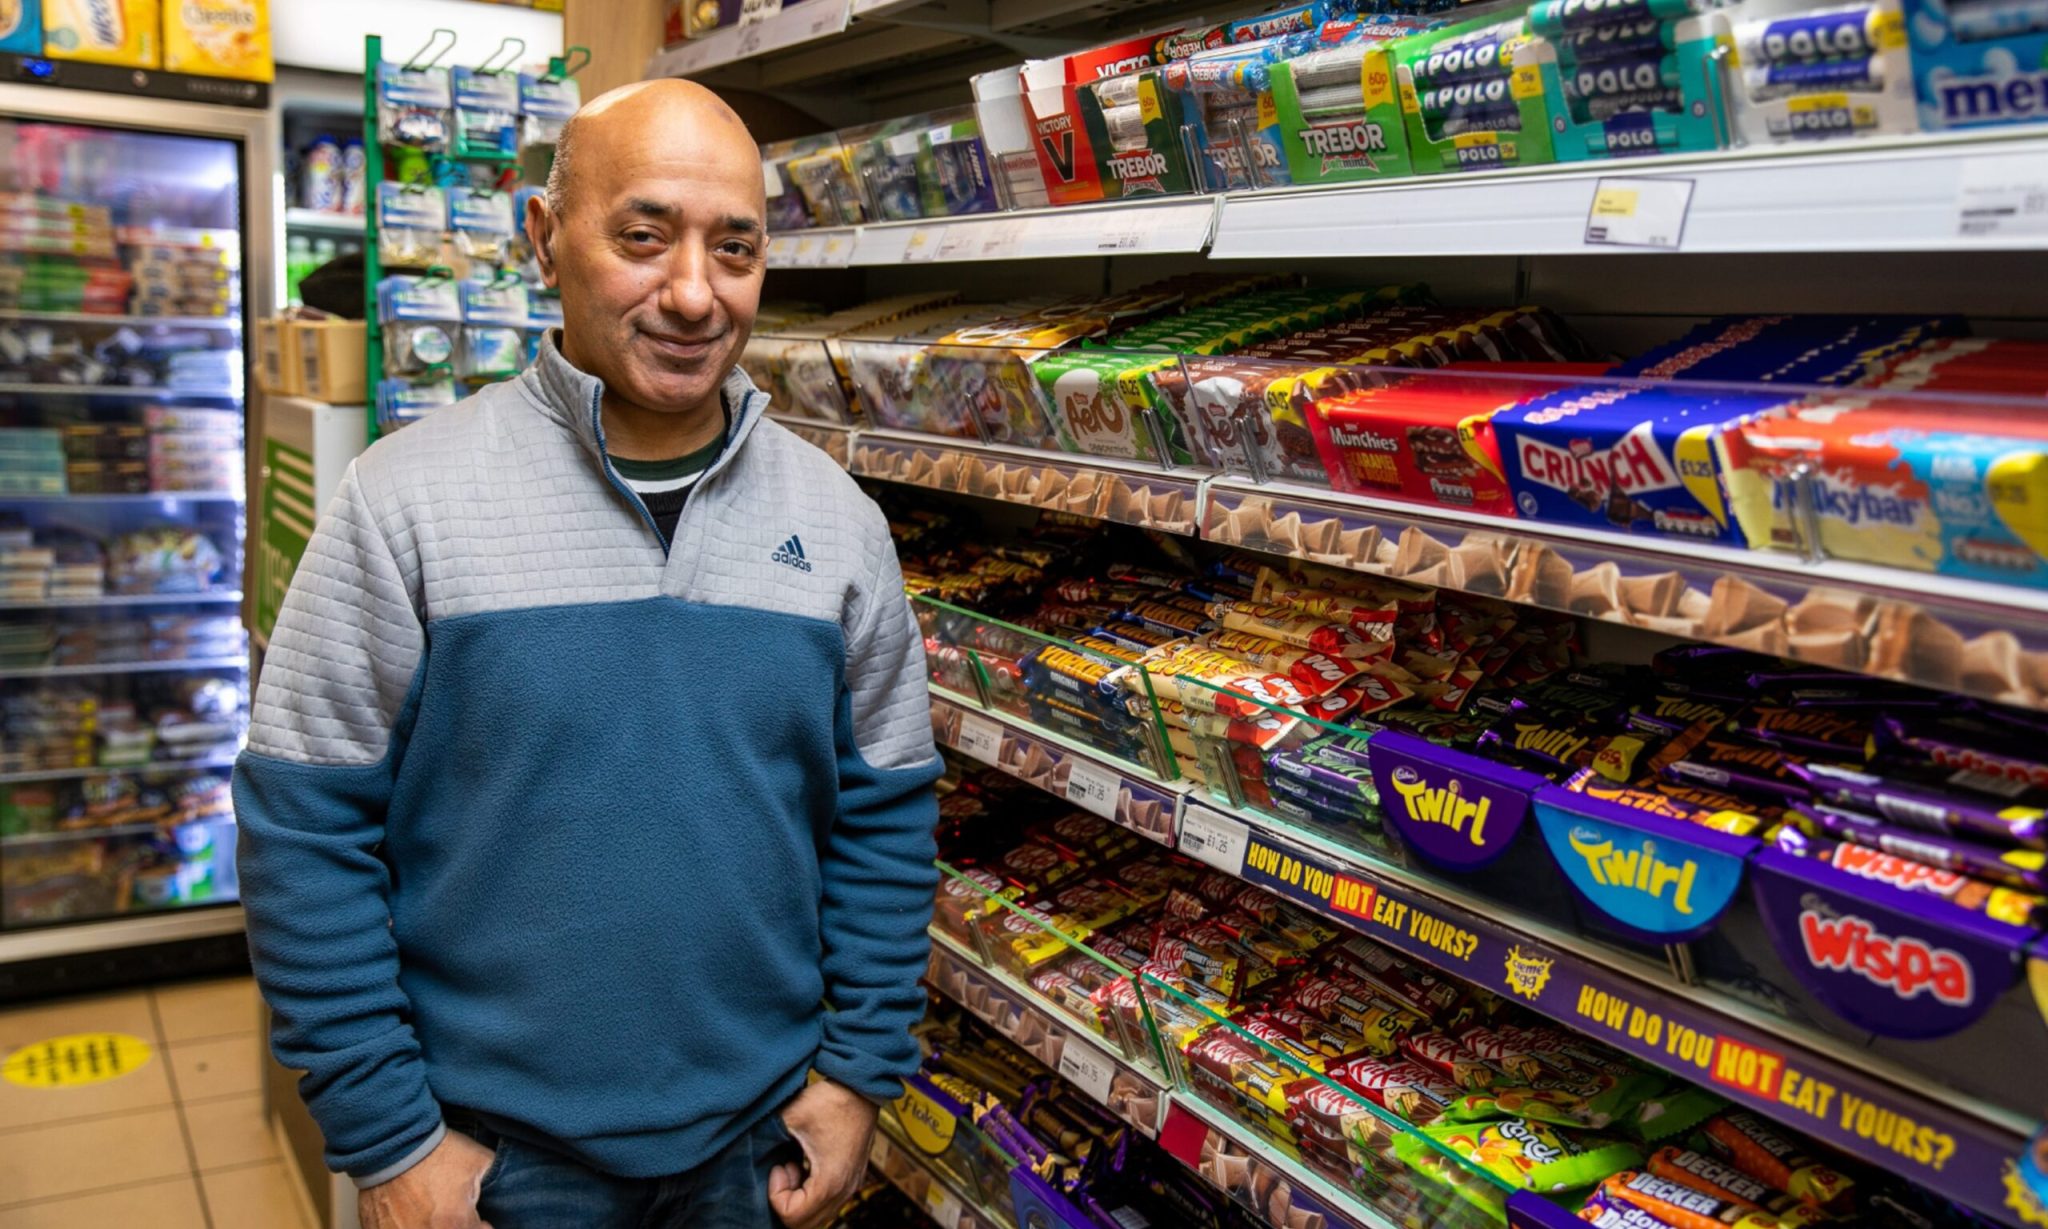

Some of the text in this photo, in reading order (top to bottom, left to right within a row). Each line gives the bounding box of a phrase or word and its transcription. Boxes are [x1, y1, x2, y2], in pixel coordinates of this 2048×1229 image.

[1766, 24, 1860, 59] POLO
[1428, 44, 1496, 76] POLO
[1438, 79, 1505, 107] POLO
[1578, 64, 1657, 96] POLO
[1036, 114, 1073, 136] VICTORY
[1299, 123, 1386, 156] TREBOR
[1606, 129, 1655, 149] POLO
[1040, 129, 1075, 184] V
[1106, 153, 1169, 181] TREBOR
[1458, 146, 1499, 163] POLO
[1119, 379, 1141, 397] £1.25
[1329, 425, 1399, 453] Munchies
[1355, 451, 1398, 472] CARAMEL
[1523, 434, 1666, 496] CRUNCH
[1679, 458, 1713, 478] £1.25
[1772, 478, 1922, 526] Mlkybar
[771, 551, 813, 573] adidas
[1036, 644, 1113, 686] YORKIE
[1302, 653, 1347, 681] DUO
[1049, 671, 1080, 692] ORIGINAL
[1515, 722, 1590, 765] Twirl
[1391, 770, 1492, 847] Twirl
[1206, 834, 1228, 855] £1.25
[1568, 828, 1699, 915] Twirl
[1832, 841, 1969, 897] Wispa
[1246, 842, 1479, 962] HOW DO YOU NOT EAT YOURS?
[1511, 958, 1546, 977] creme
[1799, 909, 1975, 1009] Wispa
[1513, 970, 1537, 989] egg
[1296, 980, 1343, 1009] KitKat
[1339, 1013, 1364, 1034] CARAMEL
[1378, 1013, 1408, 1041] 65p
[1320, 1032, 1347, 1051] CARAMEL
[1247, 1073, 1273, 1094] CARAMEL
[1347, 1056, 1414, 1090] KitKat
[1576, 984, 1957, 1171] HOW DO YOU NOT EAT YOURS?
[1726, 1111, 1795, 1158] DECKER
[1671, 1149, 1767, 1201] DECKER
[1626, 1171, 1721, 1216] DECKER
